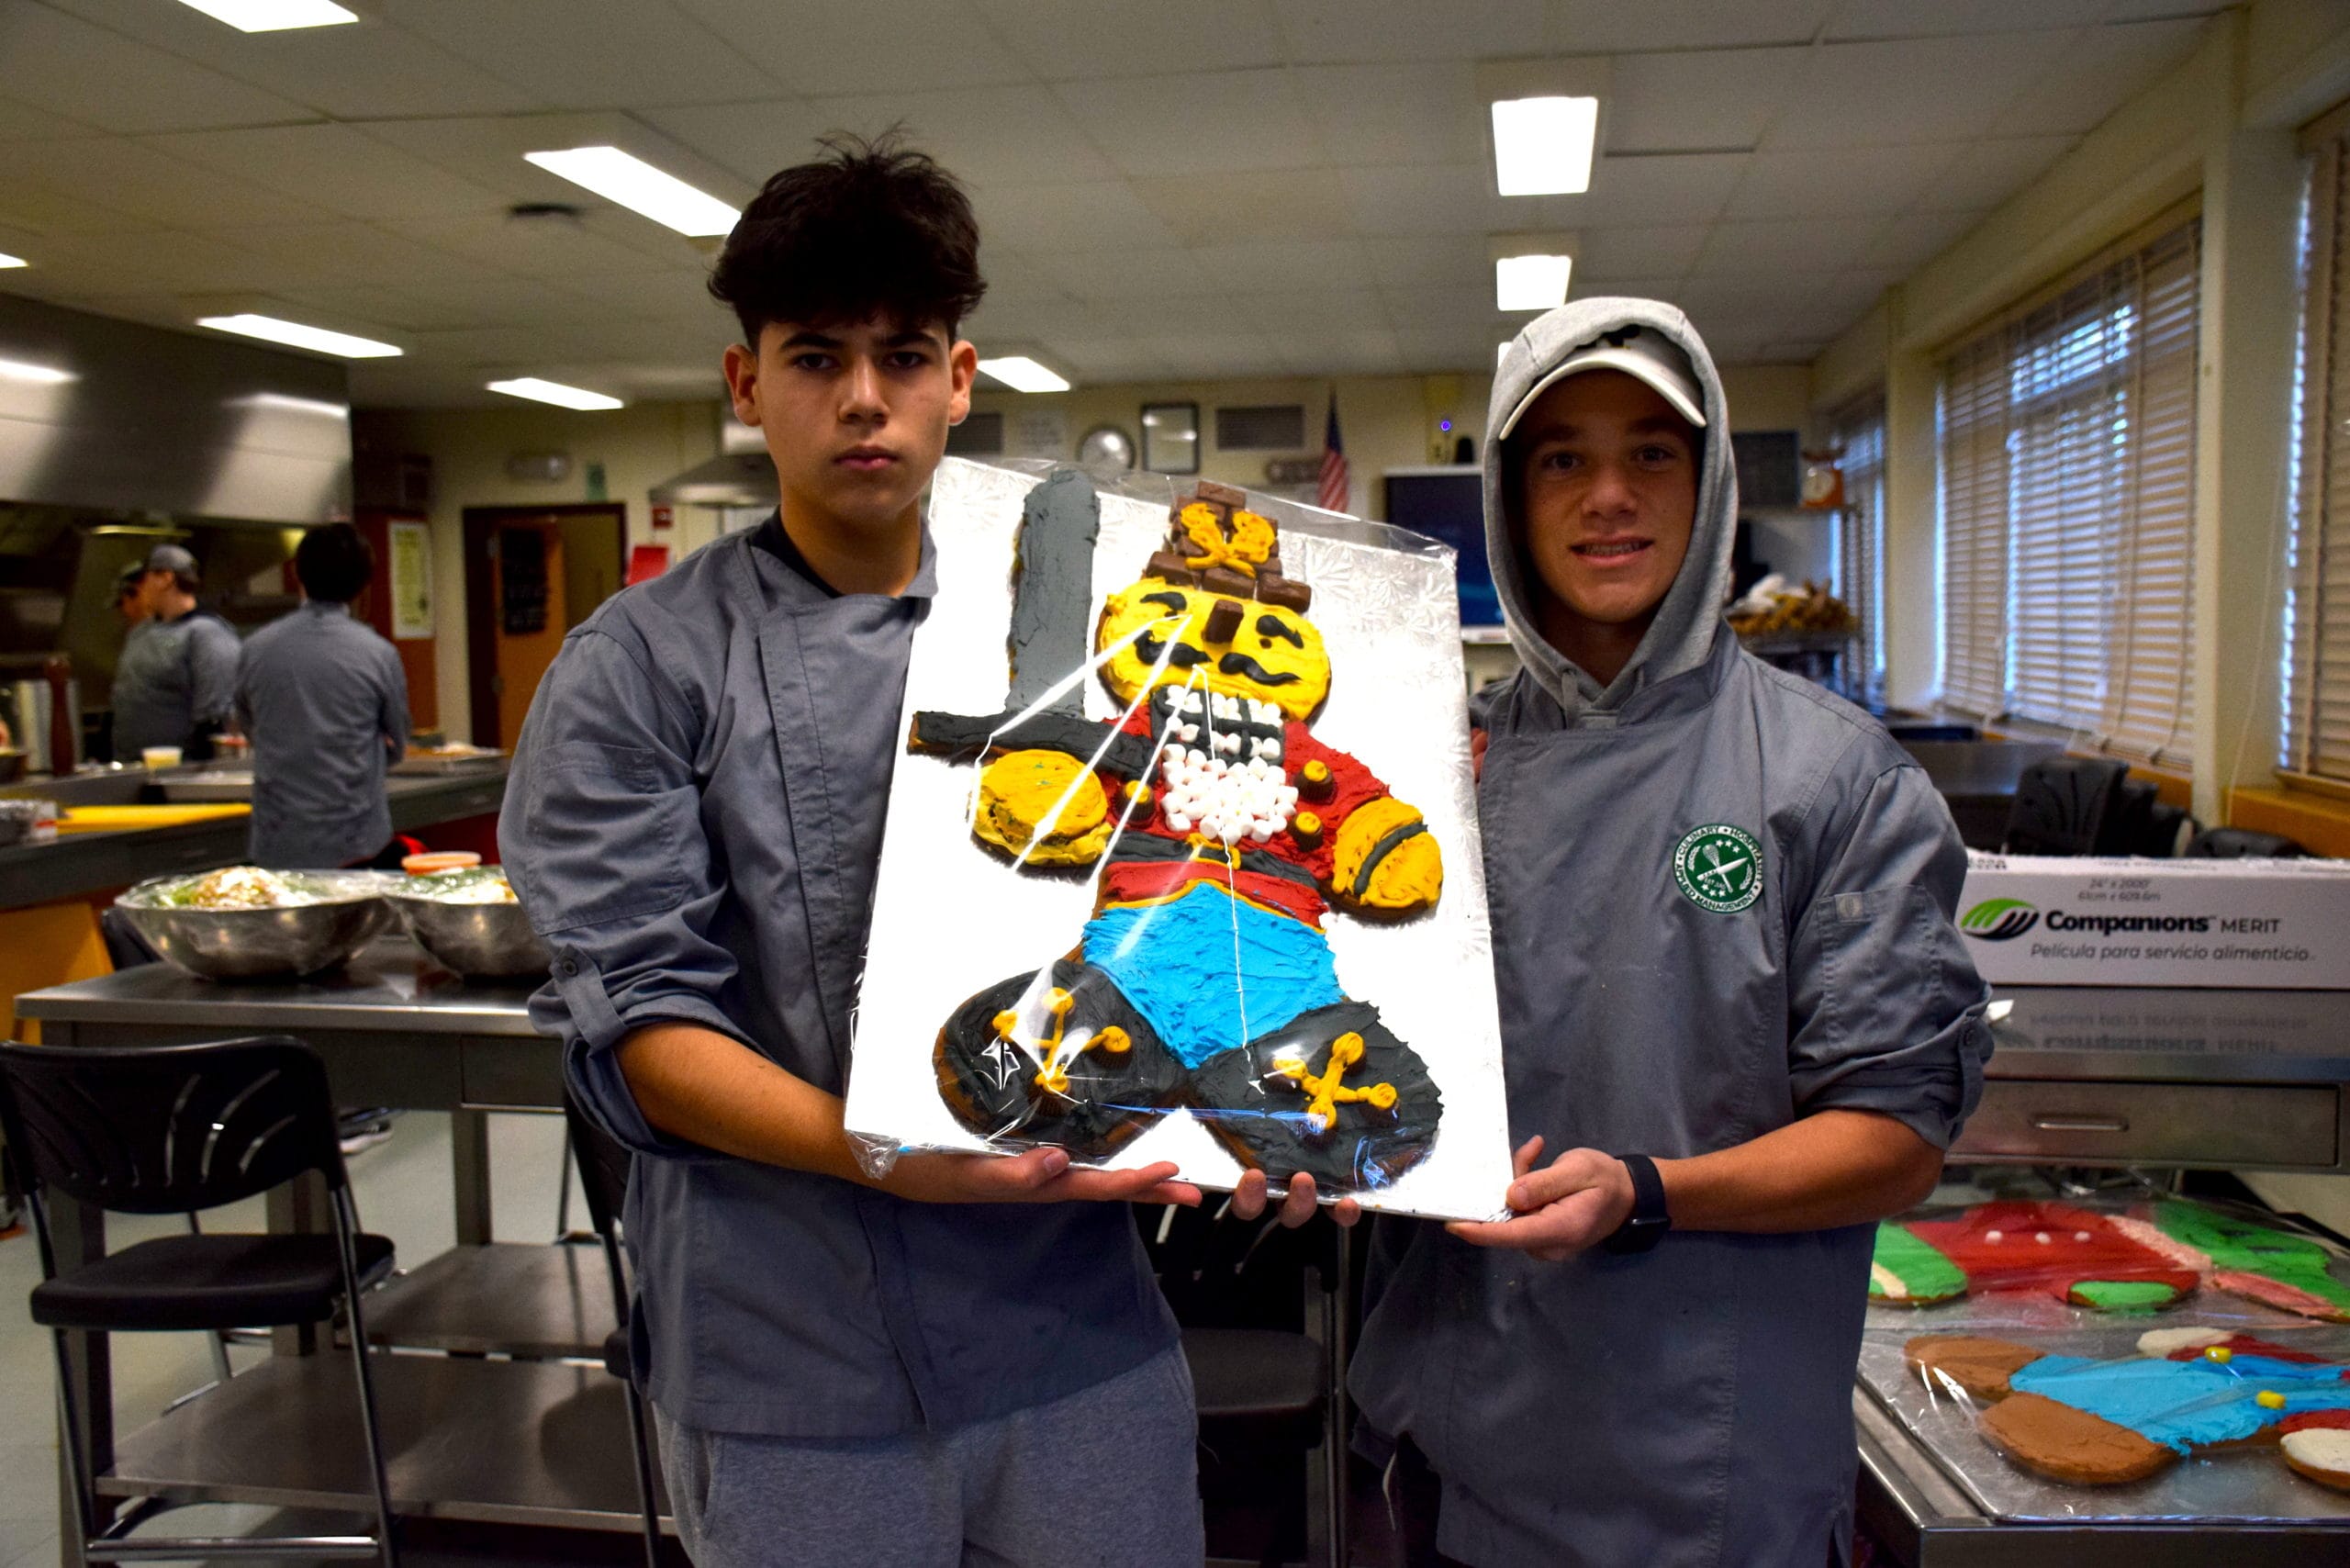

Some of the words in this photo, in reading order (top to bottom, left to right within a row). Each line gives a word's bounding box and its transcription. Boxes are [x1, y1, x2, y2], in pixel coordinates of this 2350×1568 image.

[1678, 827, 1718, 856] CULINARY
[1695, 890, 1756, 911] MANAGEMENT
[2221, 919, 2279, 934] MERIT
[2031, 942, 2096, 959] Película
[2100, 946, 2142, 962] para
[2144, 943, 2209, 960] servicio
